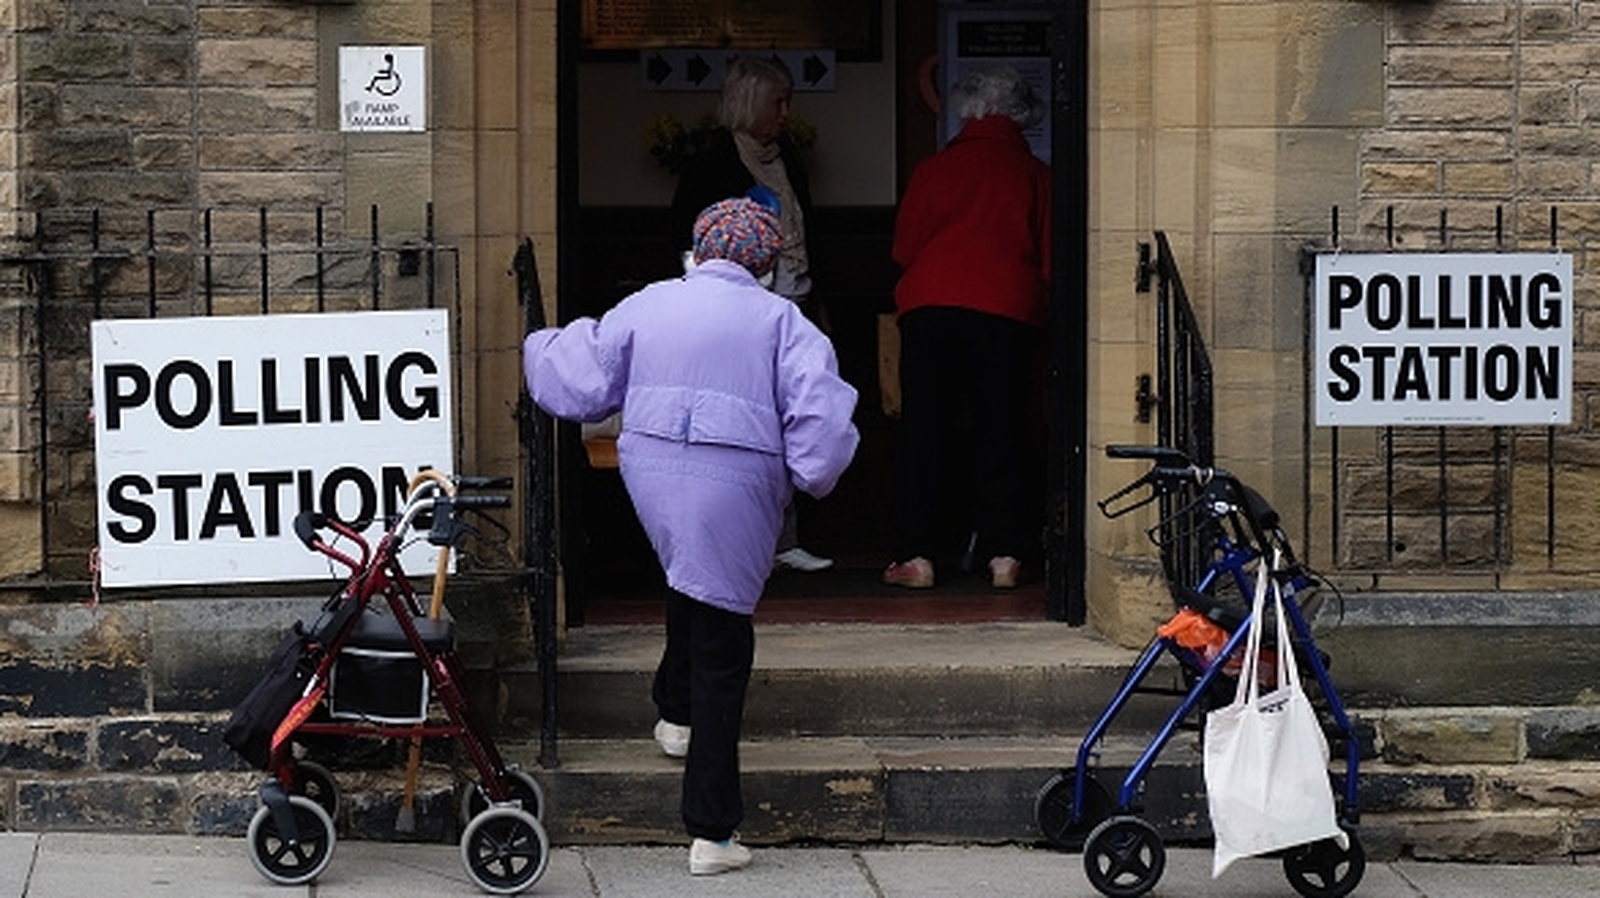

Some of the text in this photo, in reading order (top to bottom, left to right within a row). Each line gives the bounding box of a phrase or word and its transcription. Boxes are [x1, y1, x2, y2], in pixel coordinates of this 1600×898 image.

[1328, 274, 1562, 331] POLLING
[103, 351, 440, 430] POLLING
[1327, 345, 1559, 402] STATION
